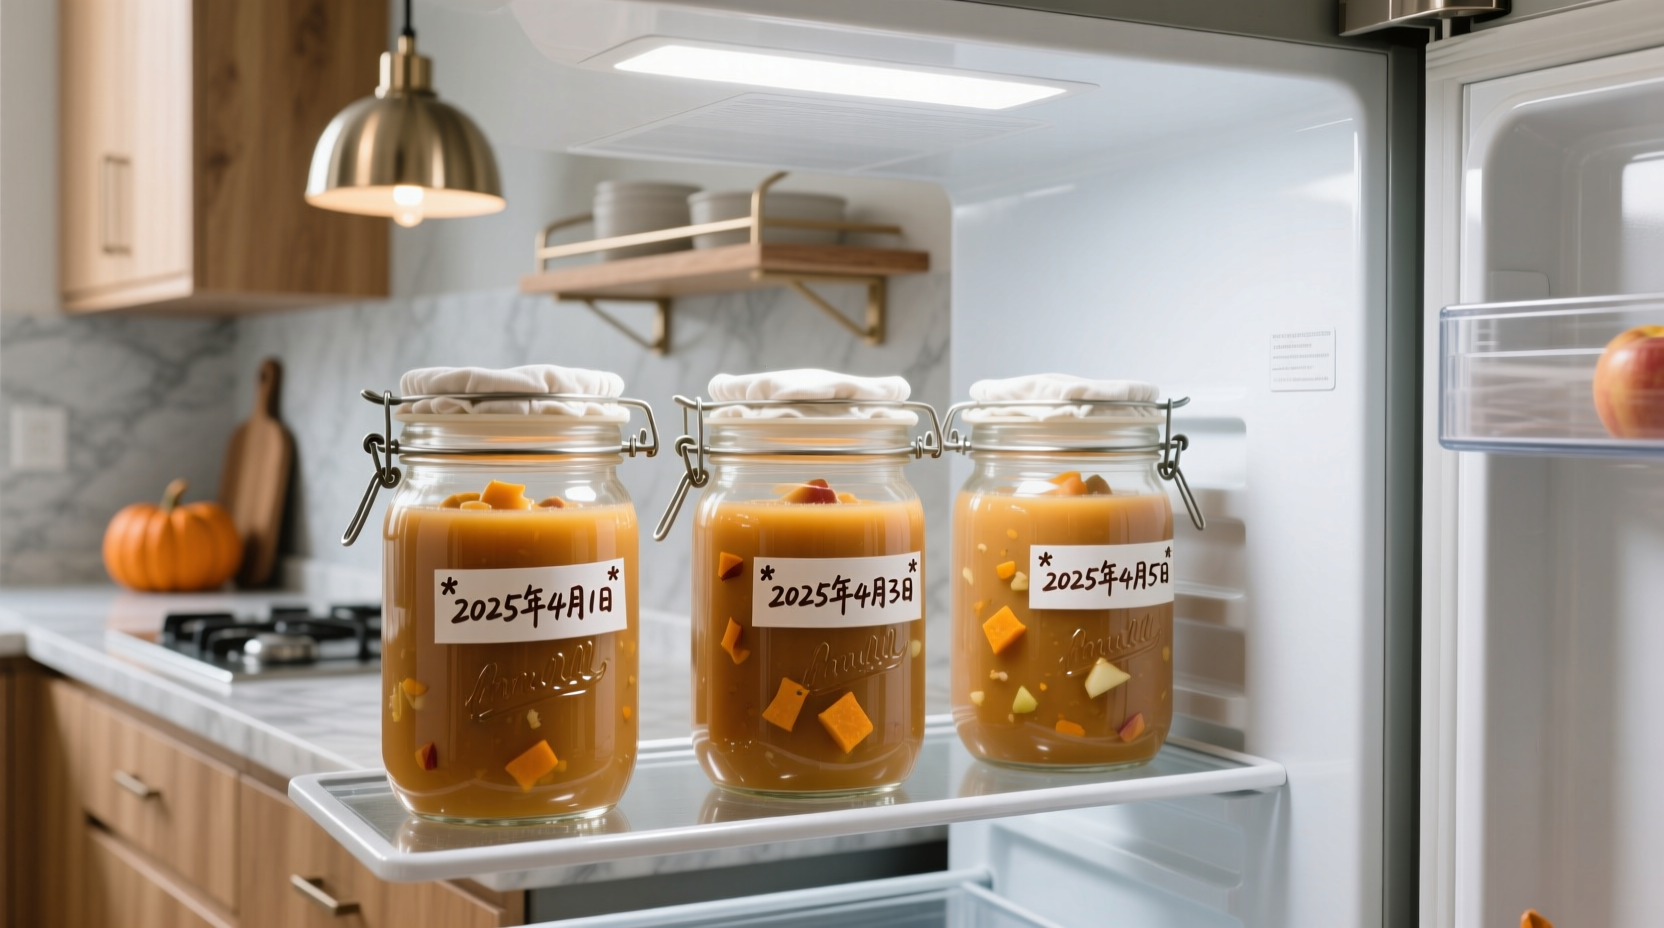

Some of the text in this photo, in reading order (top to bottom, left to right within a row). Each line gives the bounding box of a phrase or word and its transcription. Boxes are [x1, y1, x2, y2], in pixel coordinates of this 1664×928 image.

[767, 574, 914, 616] 2025年4月3日
[1041, 559, 1169, 597] 2025年4月5日
[450, 583, 613, 629] 2025年4月1日
